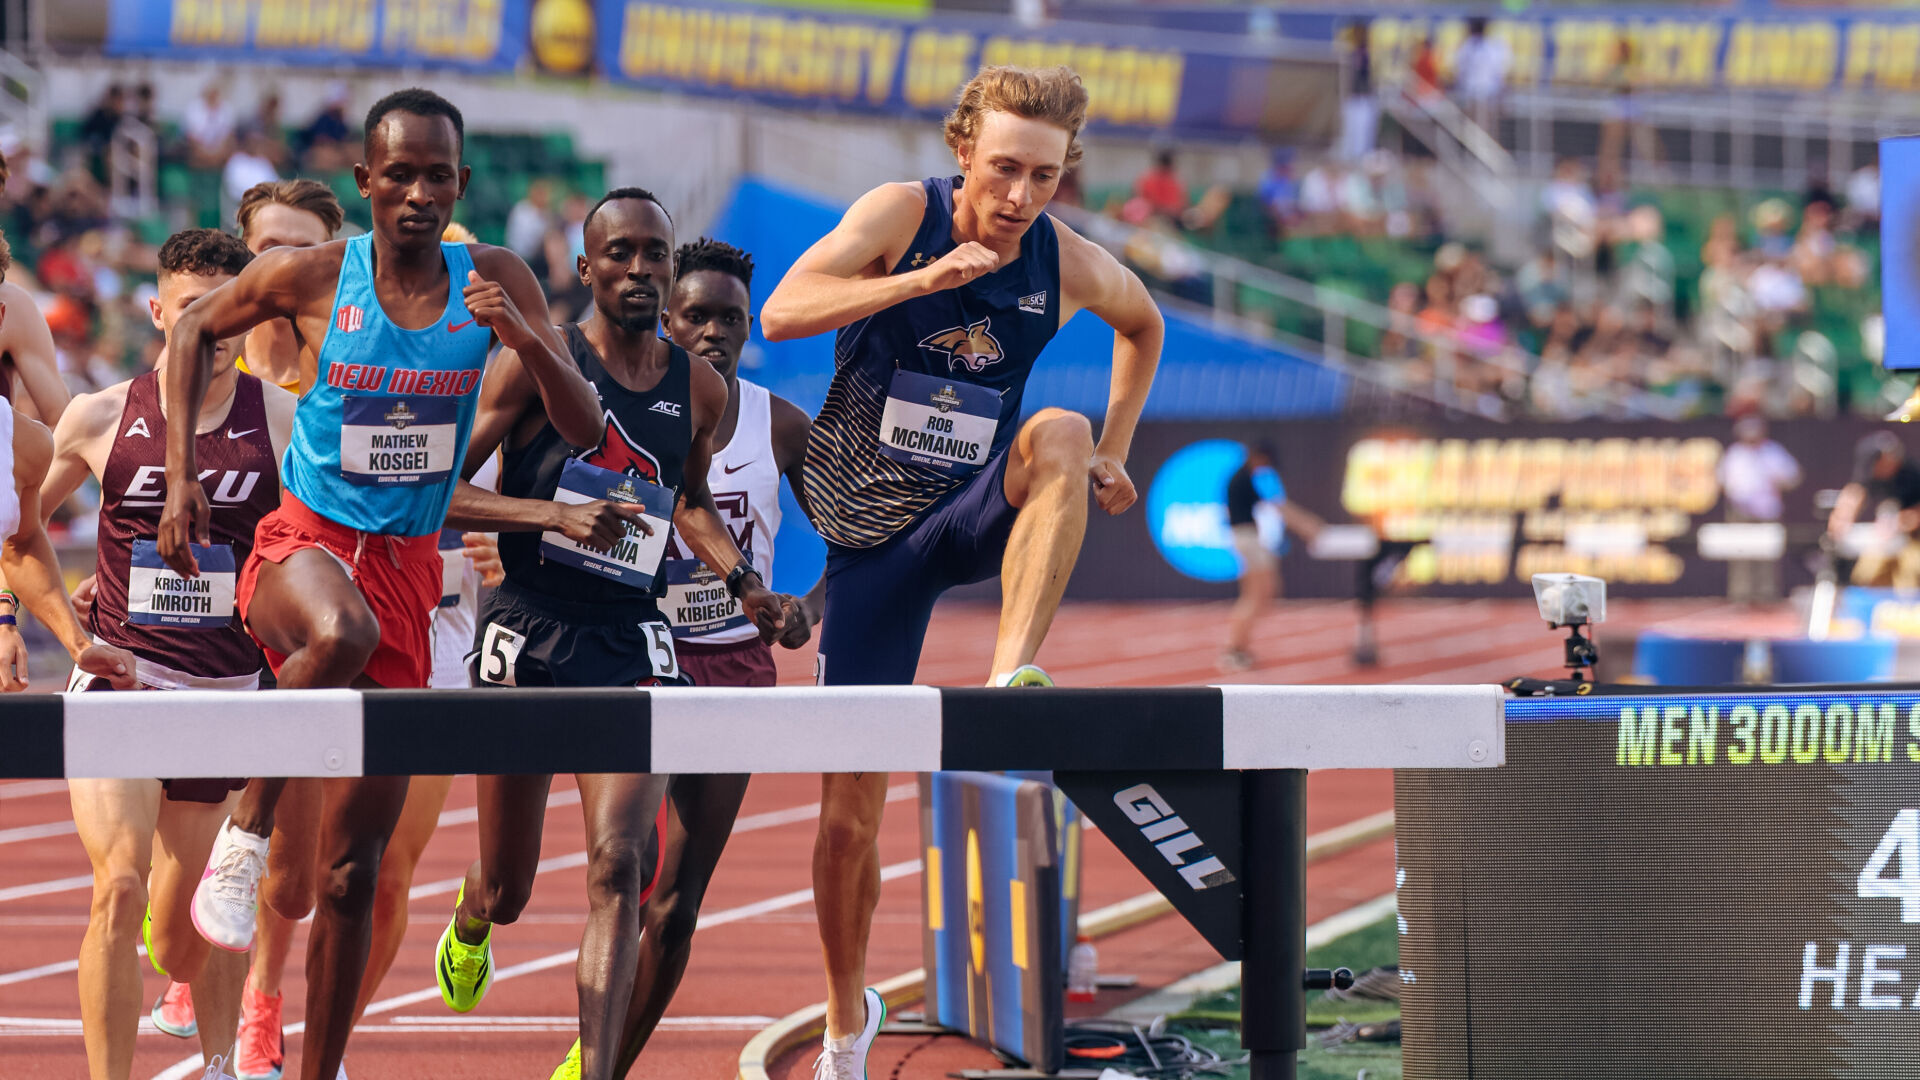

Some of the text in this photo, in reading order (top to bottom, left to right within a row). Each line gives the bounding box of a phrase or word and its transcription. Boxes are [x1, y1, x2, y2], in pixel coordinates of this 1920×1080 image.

[327, 362, 481, 396] NEW MEXICO
[650, 400, 682, 416] ACC
[926, 415, 954, 433] ROB
[371, 434, 428, 449] MATHEW
[890, 426, 980, 461] MCMANUS
[369, 451, 429, 471] KOSGEI
[154, 577, 210, 593] KRISTIAN
[684, 587, 726, 604] VICTOR
[151, 594, 212, 613] IMROTH
[677, 600, 735, 623] KIBIEGO
[487, 629, 515, 682] 5
[650, 624, 675, 675] 5
[1615, 705, 1720, 766] MEN
[1726, 703, 1897, 765] 3000M
[1113, 783, 1236, 890] GILL
[1797, 941, 1920, 1011] HE
